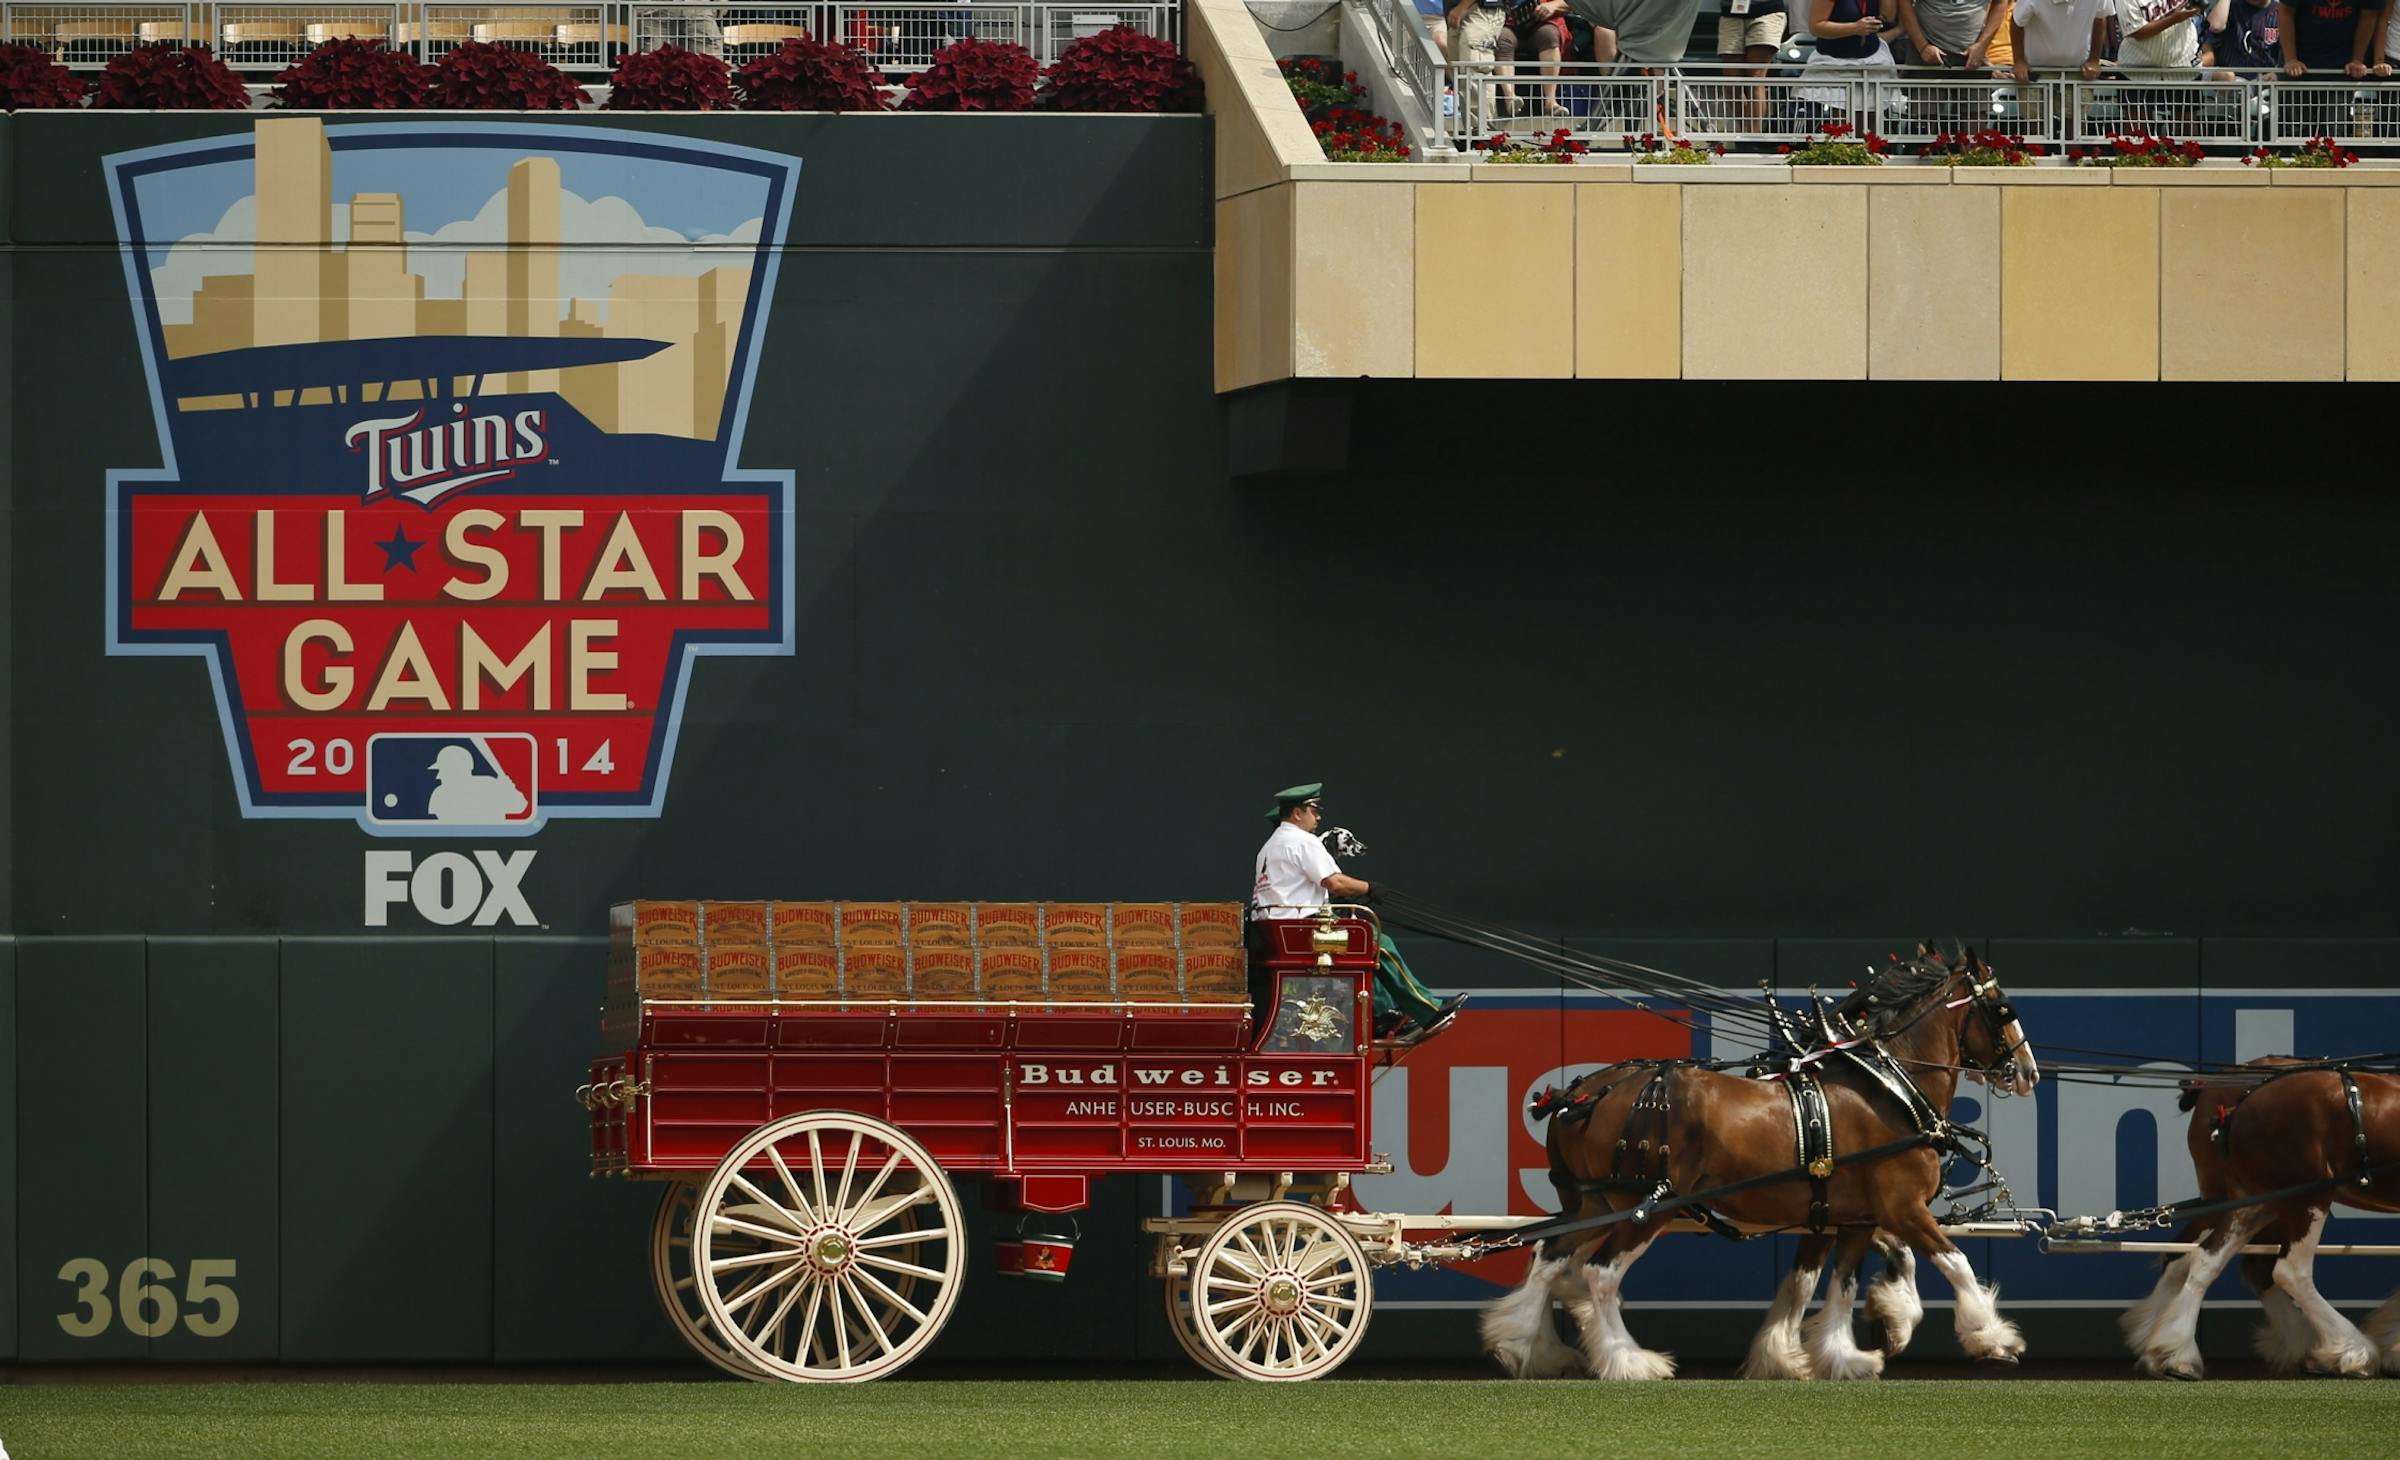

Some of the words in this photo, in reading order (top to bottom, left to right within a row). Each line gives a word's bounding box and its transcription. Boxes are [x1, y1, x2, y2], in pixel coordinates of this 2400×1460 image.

[345, 402, 549, 502] Twins
[157, 509, 385, 601] ALL
[442, 509, 755, 601] STAR
[284, 618, 628, 712] GAME
[286, 738, 355, 776] 20
[556, 738, 615, 776] 14
[364, 850, 541, 927] FOX
[638, 907, 697, 930] BUDWEISER
[706, 907, 765, 931] BUDWEISER
[774, 908, 833, 931] BUDWEISER
[842, 908, 901, 931] BUDWEISER
[910, 908, 969, 931] BUDWEISER
[978, 908, 1037, 931] BUDWEISER
[1045, 909, 1103, 932] BUDWEISER
[1114, 909, 1172, 932] BUDWEISER
[1181, 909, 1239, 932] BUDWEISER
[641, 951, 700, 974] BUDWEISER
[710, 951, 769, 974] BUDWEISER
[778, 952, 837, 975] BUDWEISER
[846, 952, 905, 976] BUDWEISER
[914, 953, 972, 976] BUDWEISER
[982, 953, 1040, 976] BUDWEISER
[1051, 953, 1109, 977] BUDWEISER
[1118, 953, 1177, 977] BUDWEISER
[1186, 954, 1244, 977] BUDWEISER
[1269, 1102, 1305, 1116] INC.
[1138, 1137, 1156, 1148] ST.
[1201, 1137, 1226, 1148] MO.
[57, 1256, 240, 1338] 365
